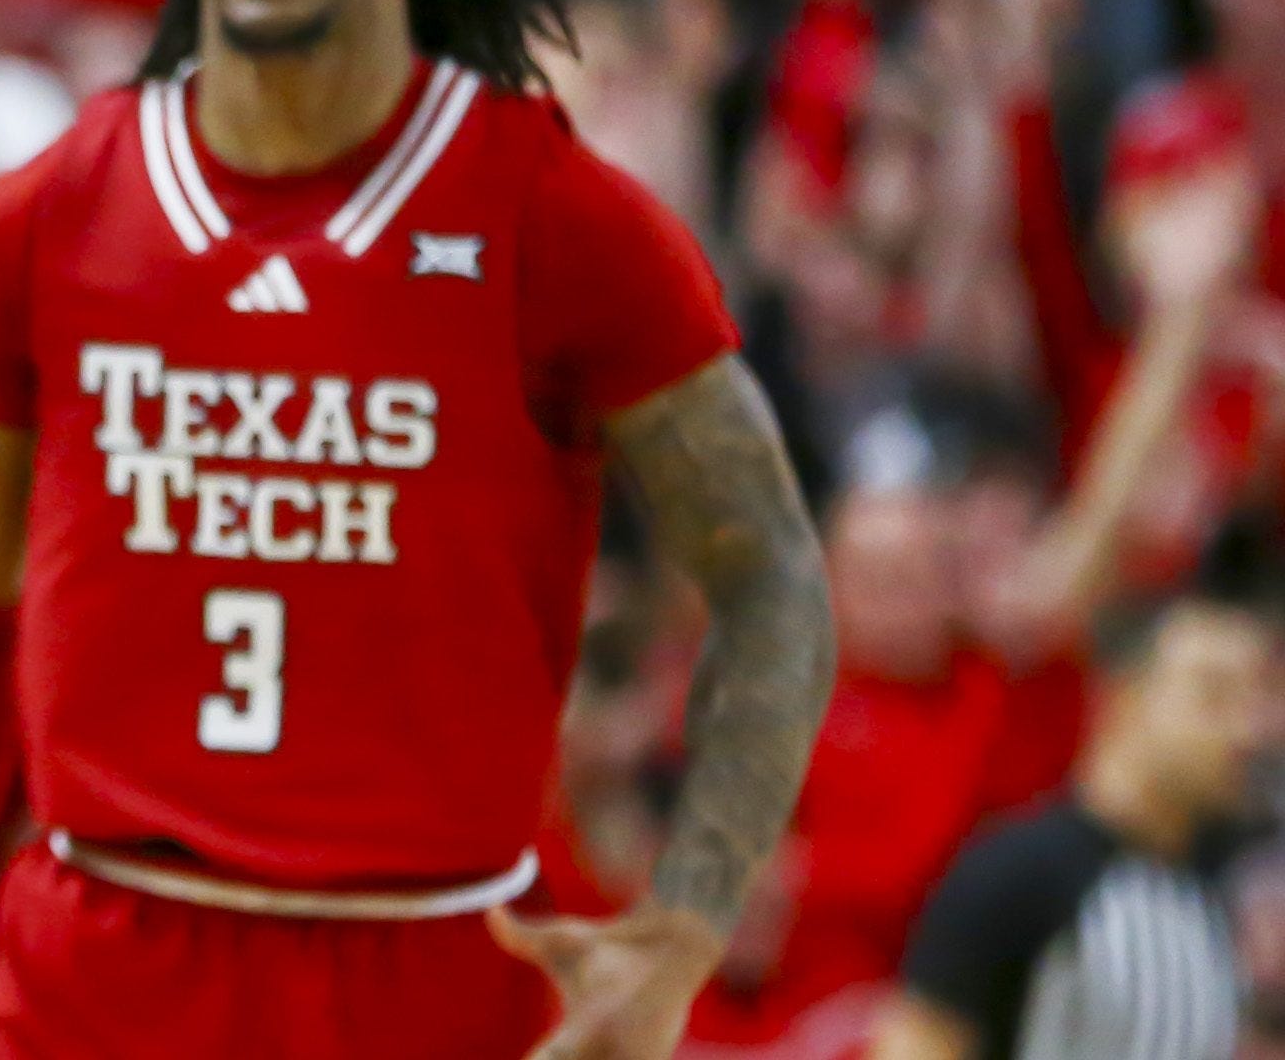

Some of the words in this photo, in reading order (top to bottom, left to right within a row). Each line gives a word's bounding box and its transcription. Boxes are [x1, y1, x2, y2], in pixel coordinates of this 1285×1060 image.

[79, 343, 438, 468] TEXAS
[105, 450, 396, 563] TECH
[197, 590, 285, 753] 3
